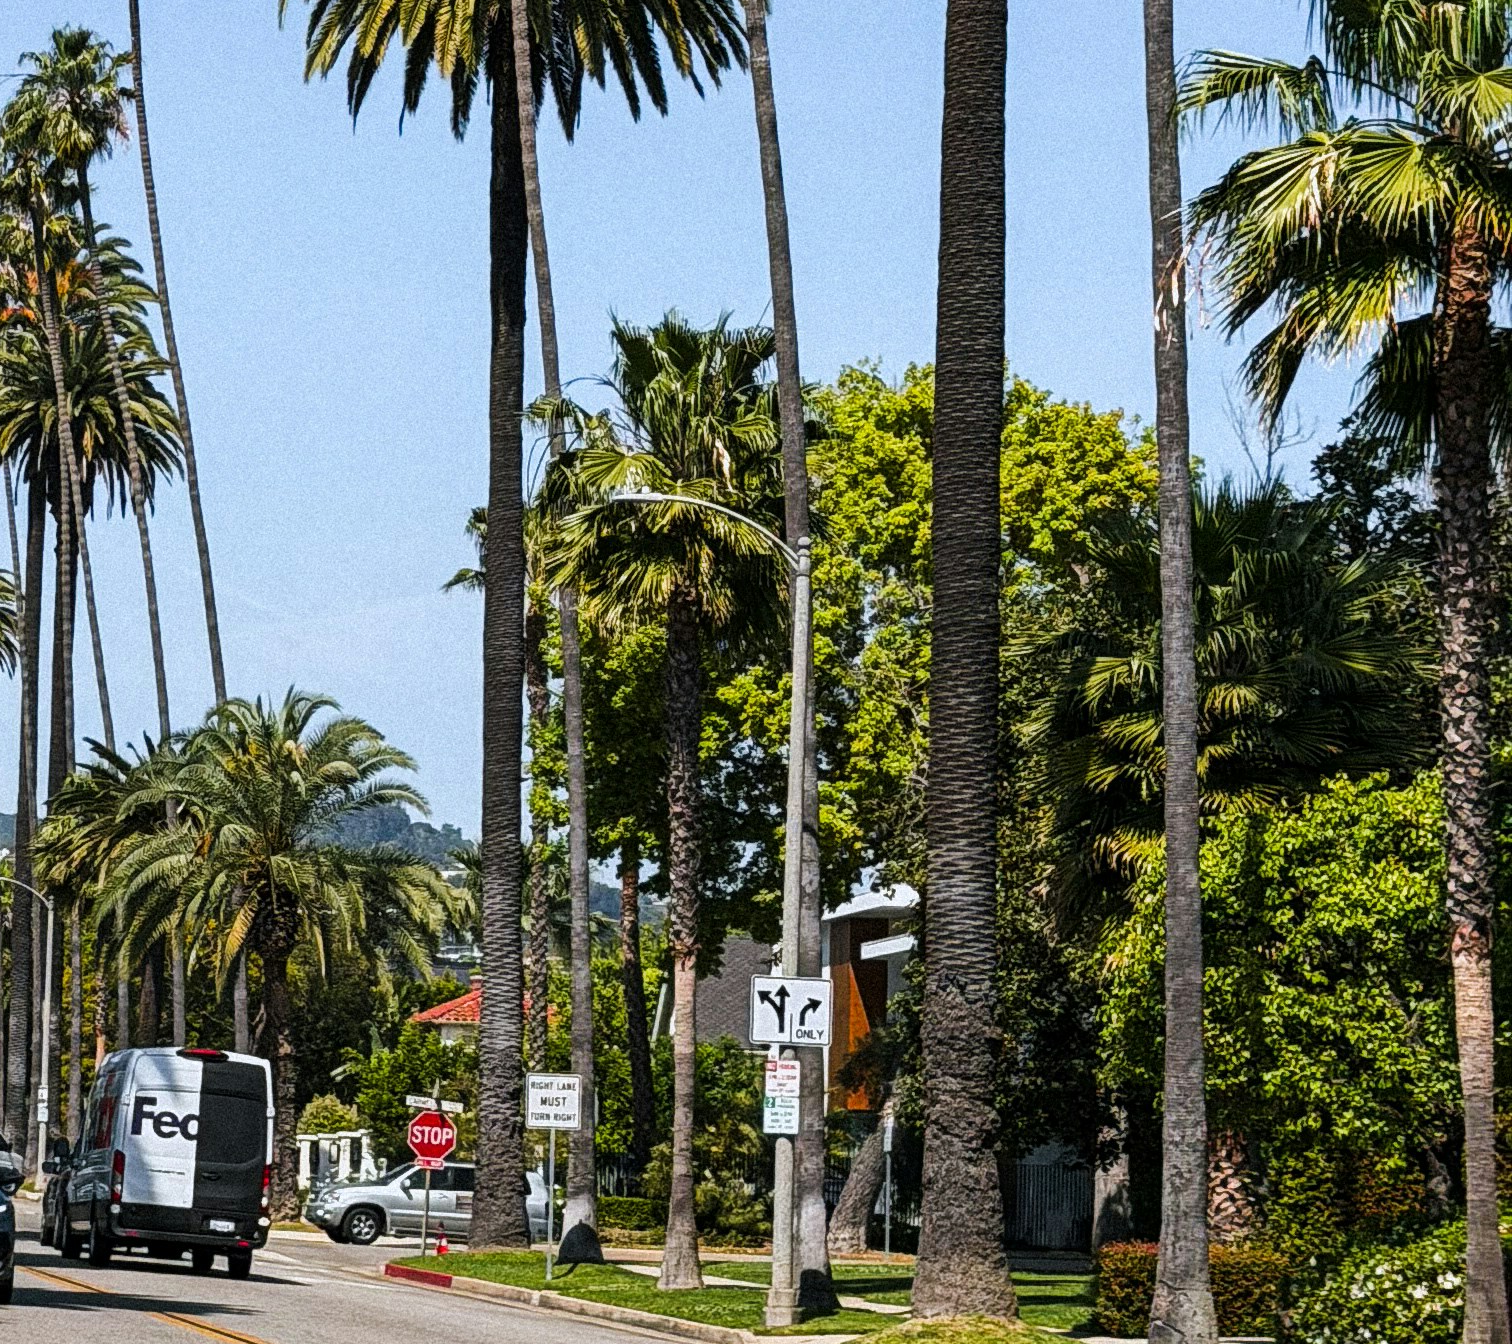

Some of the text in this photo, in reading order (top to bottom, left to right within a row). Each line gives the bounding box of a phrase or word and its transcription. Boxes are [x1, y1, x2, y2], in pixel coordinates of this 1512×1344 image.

[796, 1028, 824, 1040] ONLY
[530, 1081, 577, 1091] RIGHT LANE
[540, 1096, 567, 1107] MUST
[531, 1112, 577, 1122] TURN RIGHT
[411, 1125, 453, 1146] STOP
